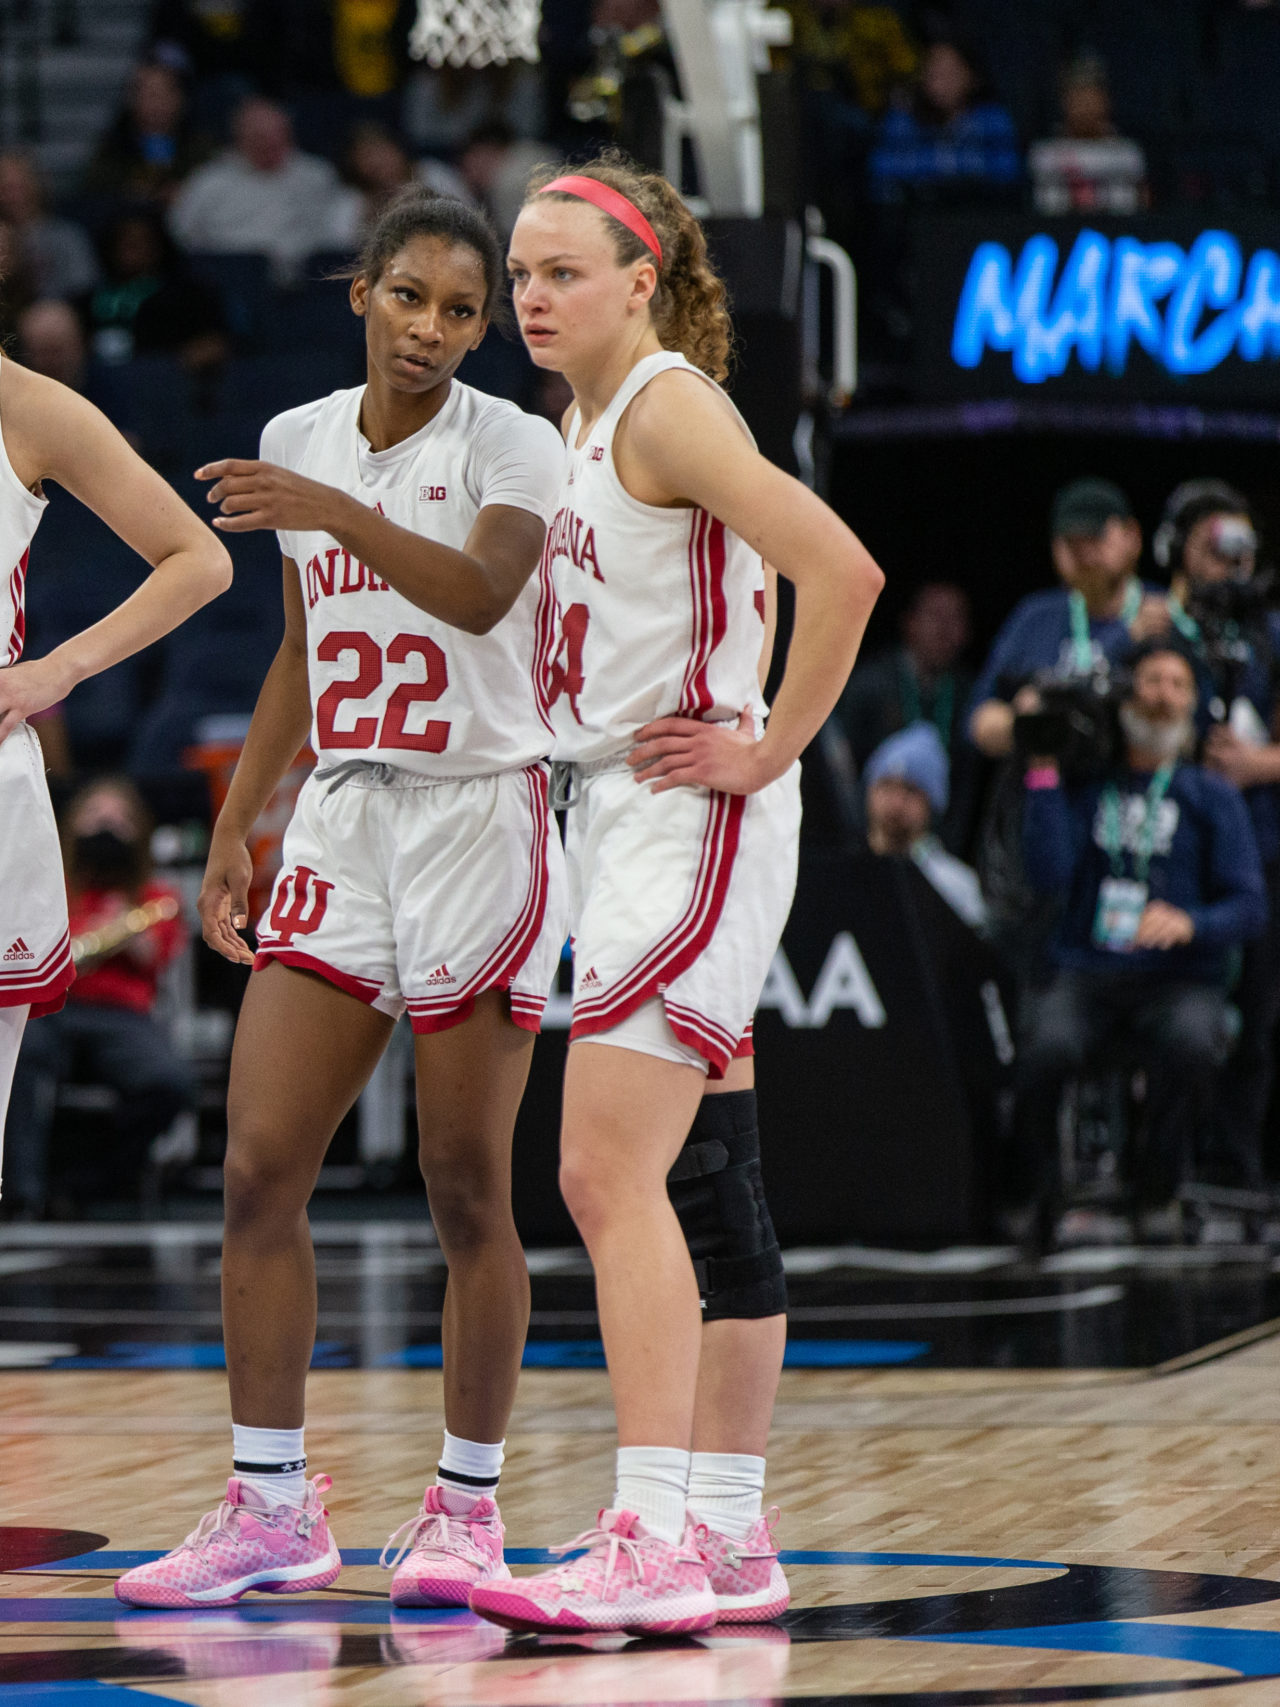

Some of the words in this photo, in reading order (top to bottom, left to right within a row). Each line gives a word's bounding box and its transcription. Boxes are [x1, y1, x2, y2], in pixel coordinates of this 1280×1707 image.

[317, 631, 452, 754] 22
[3, 951, 35, 961] adidas
[425, 976, 457, 986] adidas
[756, 930, 887, 1029] AA
